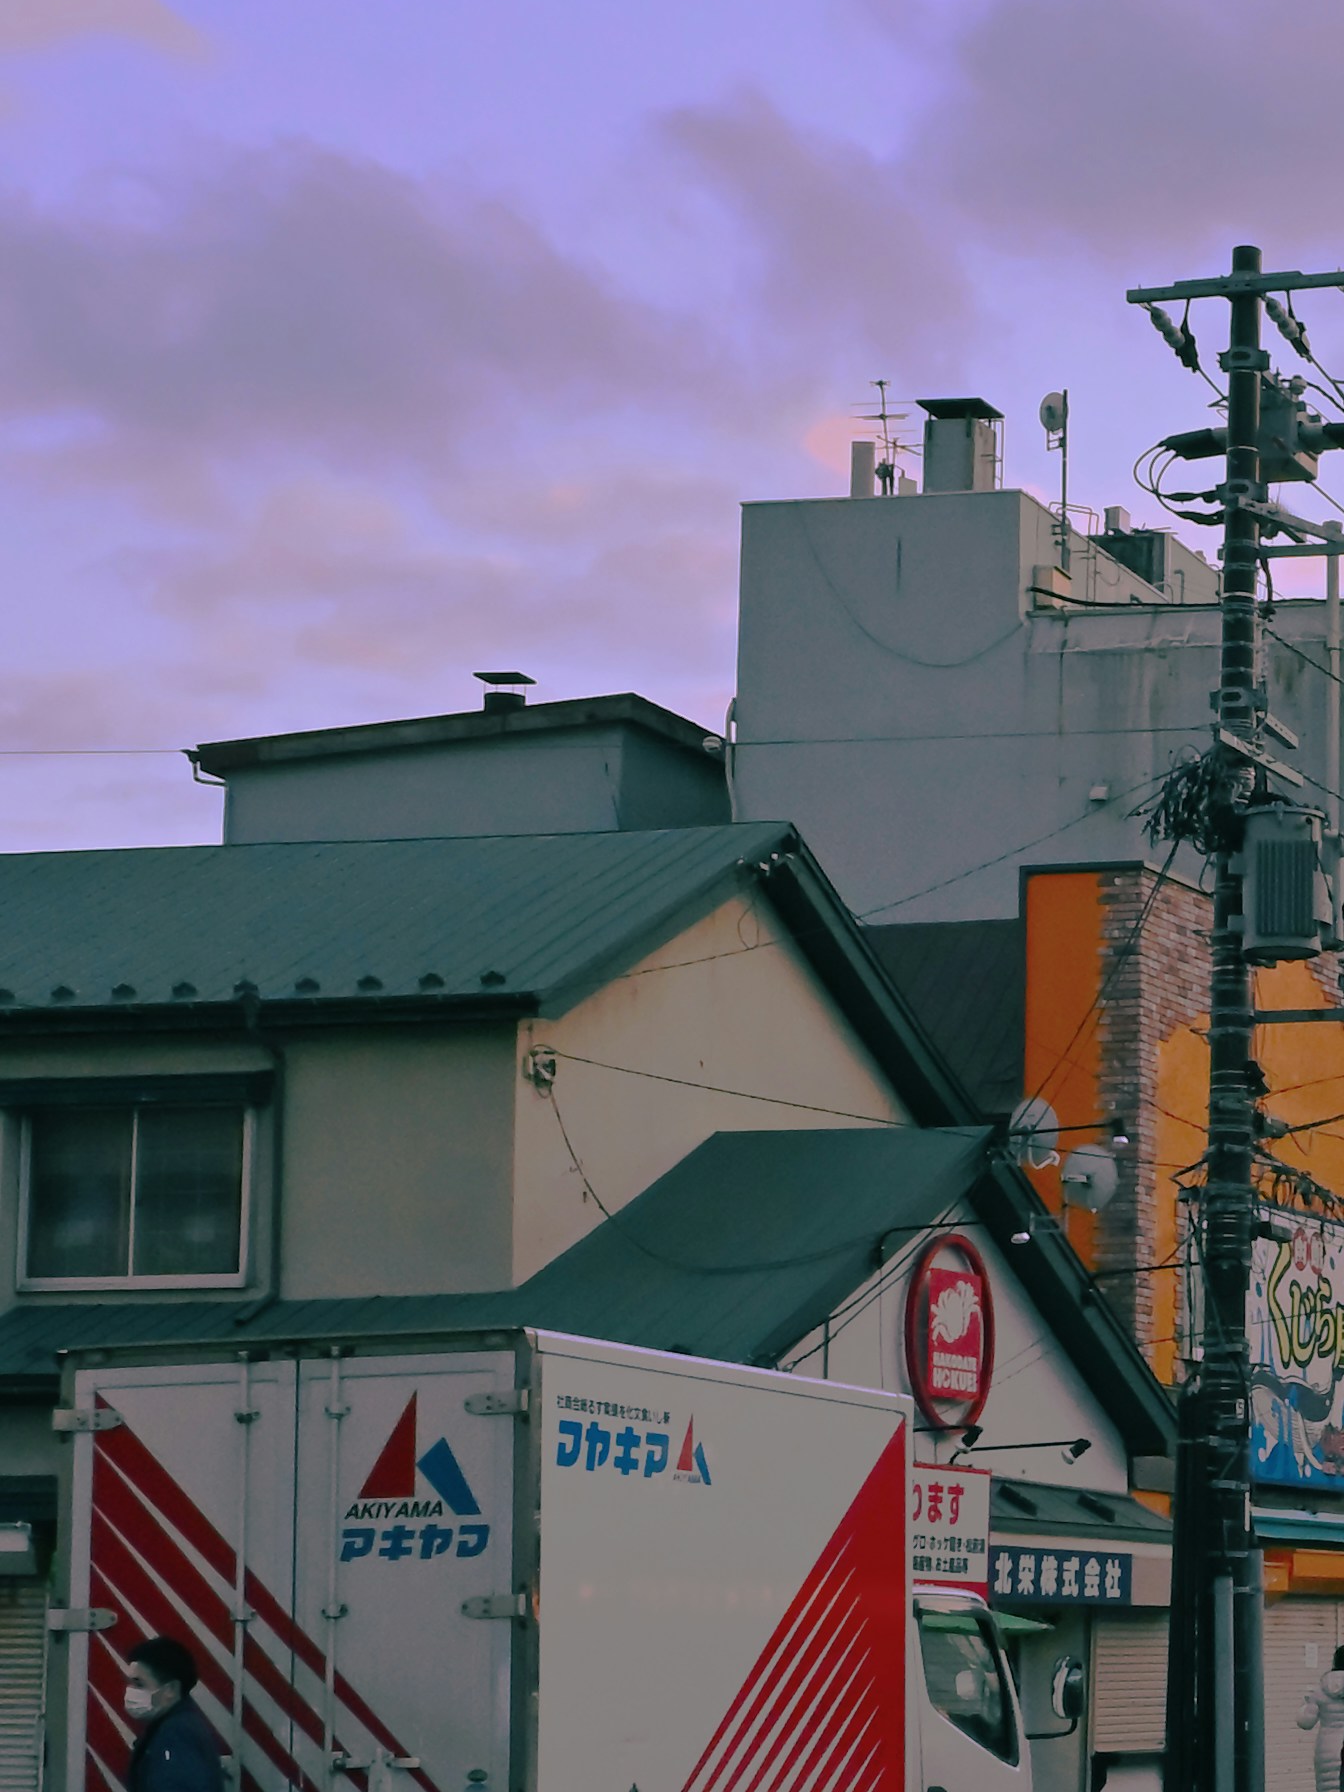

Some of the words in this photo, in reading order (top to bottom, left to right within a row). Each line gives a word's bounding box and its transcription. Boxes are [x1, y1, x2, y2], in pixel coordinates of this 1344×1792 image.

[932, 1356, 977, 1372] HAKODATE
[344, 1500, 445, 1520] AKIYAMA
[339, 1523, 490, 1563] アキヤマ
[993, 1551, 1122, 1599] 北栄株式会社
